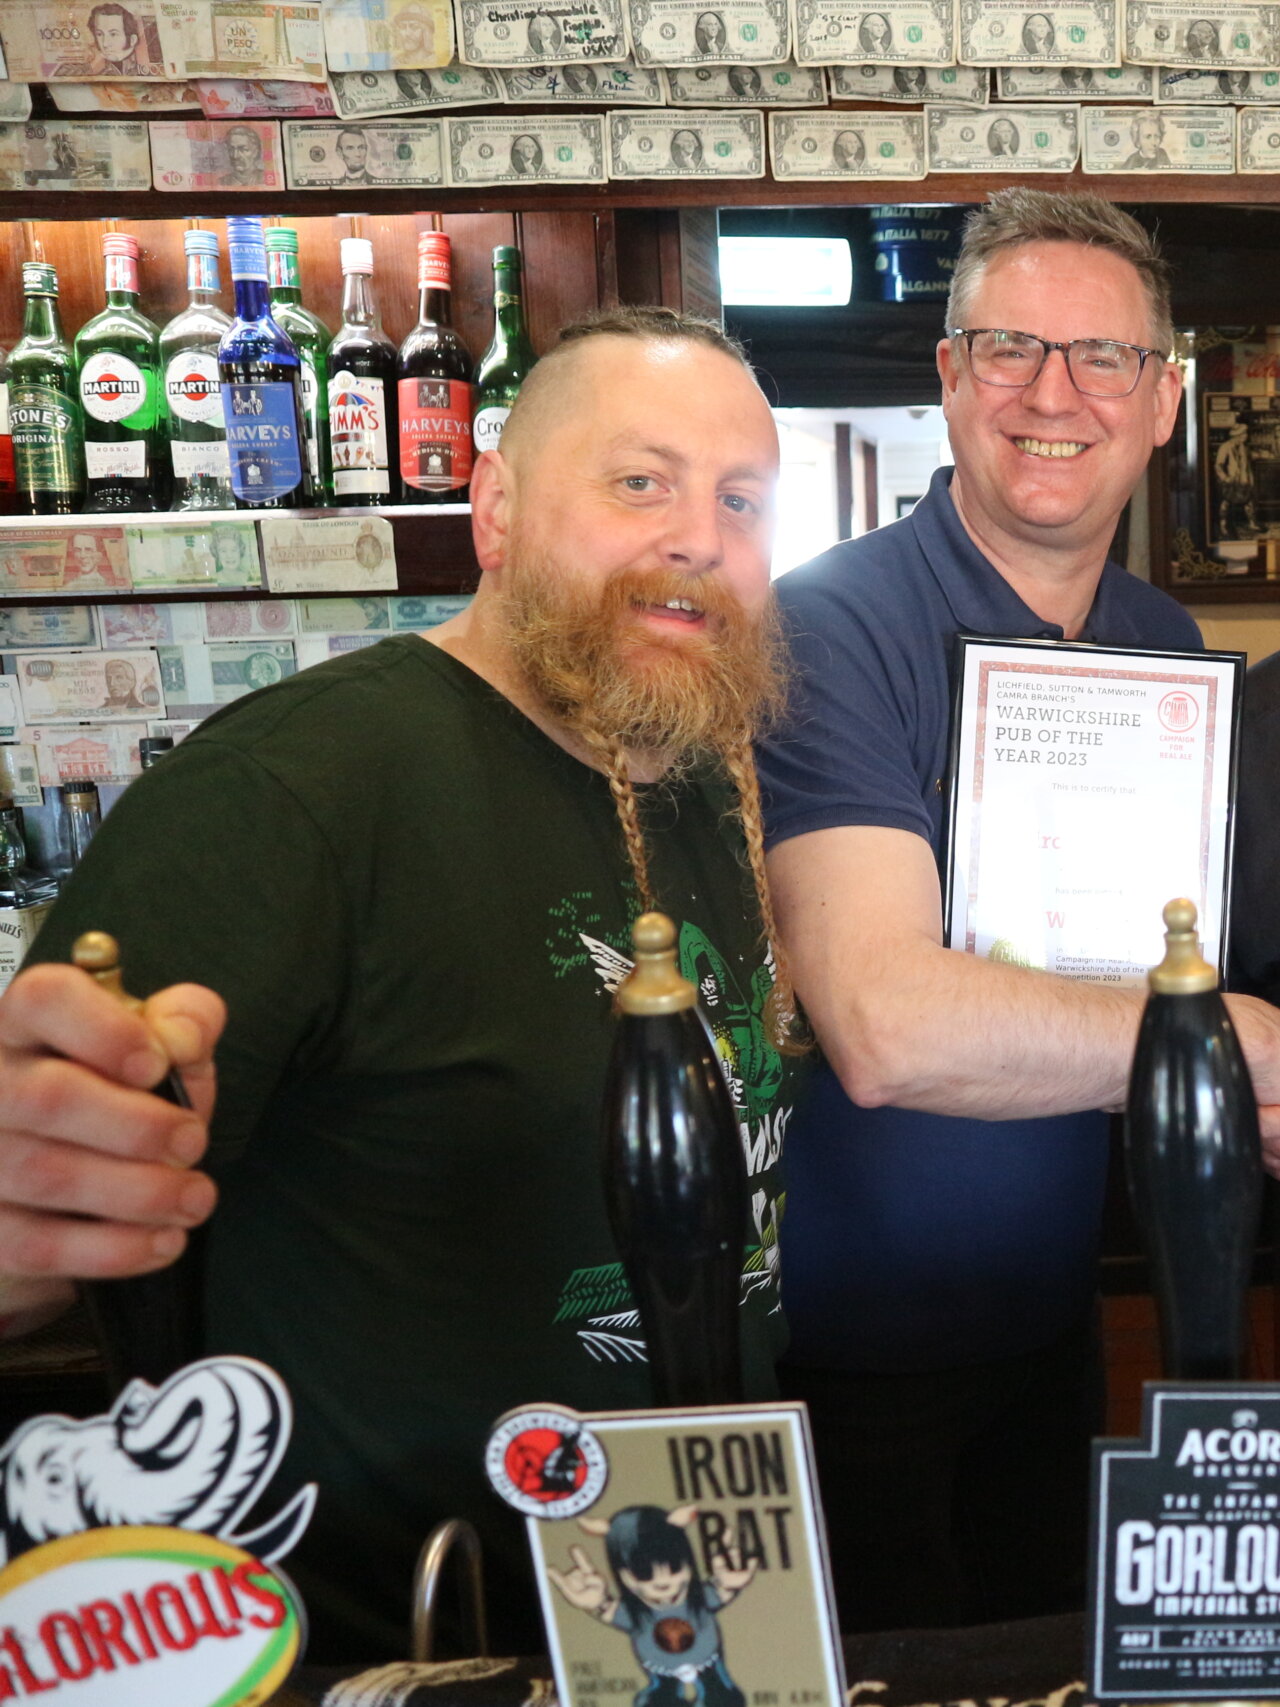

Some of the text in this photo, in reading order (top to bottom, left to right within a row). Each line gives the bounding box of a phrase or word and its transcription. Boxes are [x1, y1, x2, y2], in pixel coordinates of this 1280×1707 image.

[231, 27, 246, 37] UN
[227, 38, 252, 48] PESO
[84, 381, 139, 395] MARTINI
[169, 381, 220, 394] MARTIN
[9, 409, 67, 429] STONE'S
[402, 418, 470, 435] HARVEYS
[477, 417, 503, 436] Cro
[12, 434, 65, 443] ORIGINAL
[996, 691, 1076, 703] CAMRA BRANCH'S
[997, 681, 1147, 697] LICHFIELD, SUTTON & TAMWORTH
[996, 705, 1141, 727] WARWICKSHIRE
[33, 730, 41, 741] 5
[995, 727, 1104, 746] PUB OF THE
[994, 748, 1088, 766] YEAR 2023
[26, 784, 38, 795] 10
[1055, 964, 1105, 973] Warwickshire
[1107, 966, 1121, 974] Pub
[667, 1431, 789, 1502] IRON
[697, 1507, 794, 1573] RAT
[1154, 1595, 1249, 1616] IMPERIAL
